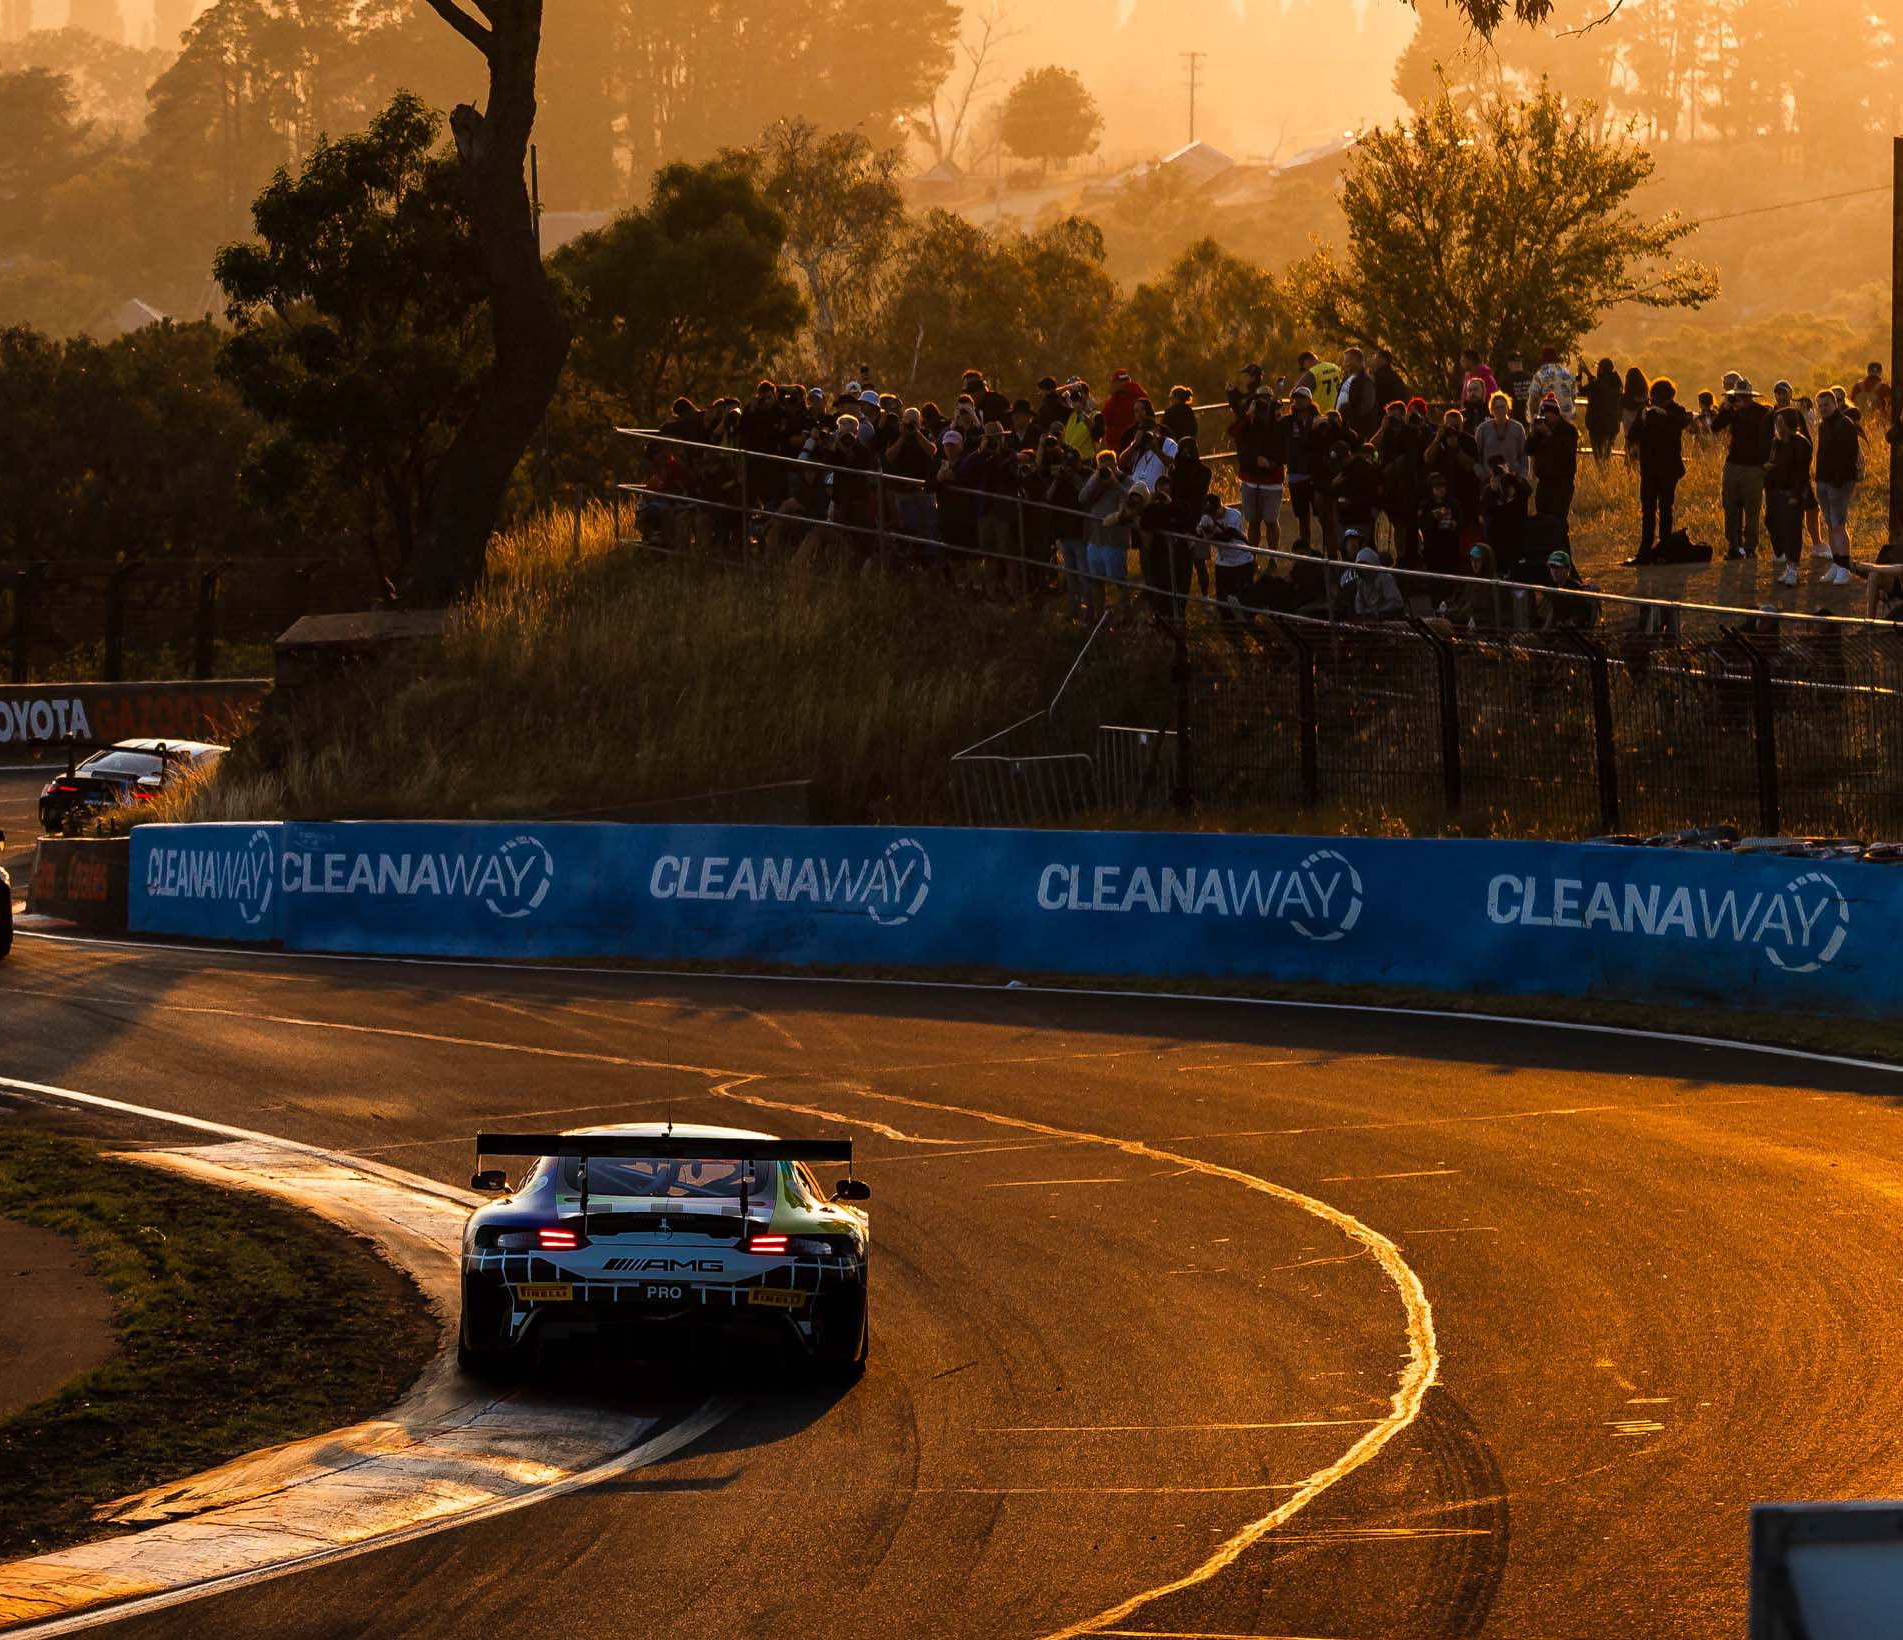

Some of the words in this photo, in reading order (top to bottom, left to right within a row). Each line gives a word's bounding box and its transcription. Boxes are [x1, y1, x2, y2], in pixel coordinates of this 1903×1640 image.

[147, 847, 266, 900] CLEANAWAY
[281, 852, 536, 897] CLEANAWAY
[650, 855, 917, 903] CLEANAWAY
[1037, 863, 1341, 918] CLEANAWAY
[1487, 874, 1829, 946] CLEANAWAY
[643, 1258, 724, 1273] AMG
[647, 1286, 682, 1299] PRO
